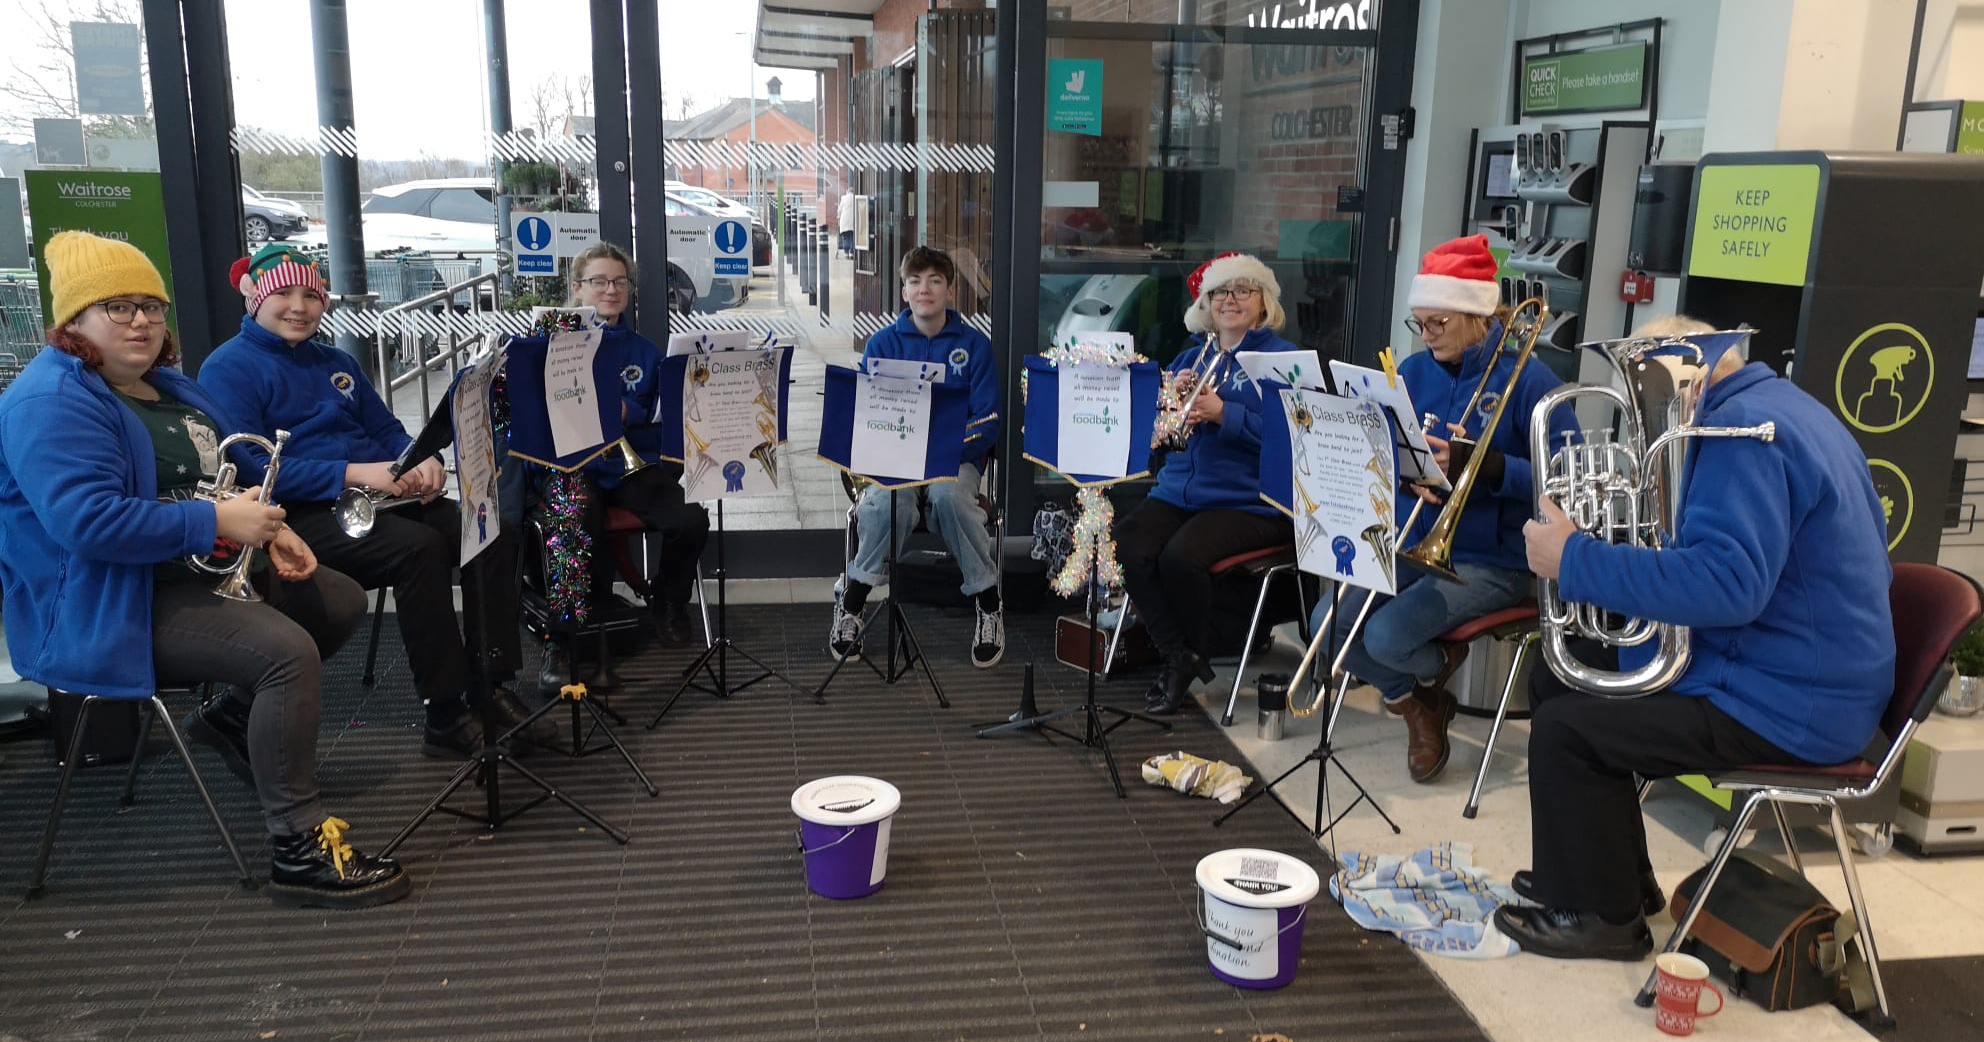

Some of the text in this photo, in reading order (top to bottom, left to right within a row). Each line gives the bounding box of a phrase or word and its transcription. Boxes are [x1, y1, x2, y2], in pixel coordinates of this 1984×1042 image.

[1530, 67, 1557, 82] QUICK
[1562, 68, 1639, 90] Please take a handset
[1529, 82, 1556, 98] CHECK
[1271, 105, 1353, 140] COLCHESTER
[57, 181, 132, 197] Waitrose
[75, 200, 117, 208] COLCHESTER
[1735, 189, 1771, 206] KEEP
[559, 227, 597, 235] Automatic
[1712, 214, 1788, 233] SHOPPING
[1721, 239, 1771, 258] SAFELY
[518, 259, 553, 268] Keep clear
[716, 263, 732, 271] Keep
[711, 361, 741, 375] Class
[744, 357, 775, 372] Brass
[554, 385, 587, 402] foodbank
[1072, 413, 1119, 426] foodbank
[1311, 404, 1345, 424] Class
[1345, 410, 1382, 429] Brass
[867, 420, 916, 434] foodbank
[1234, 881, 1279, 891] THANK YOU!
[1234, 926, 1255, 942] you
